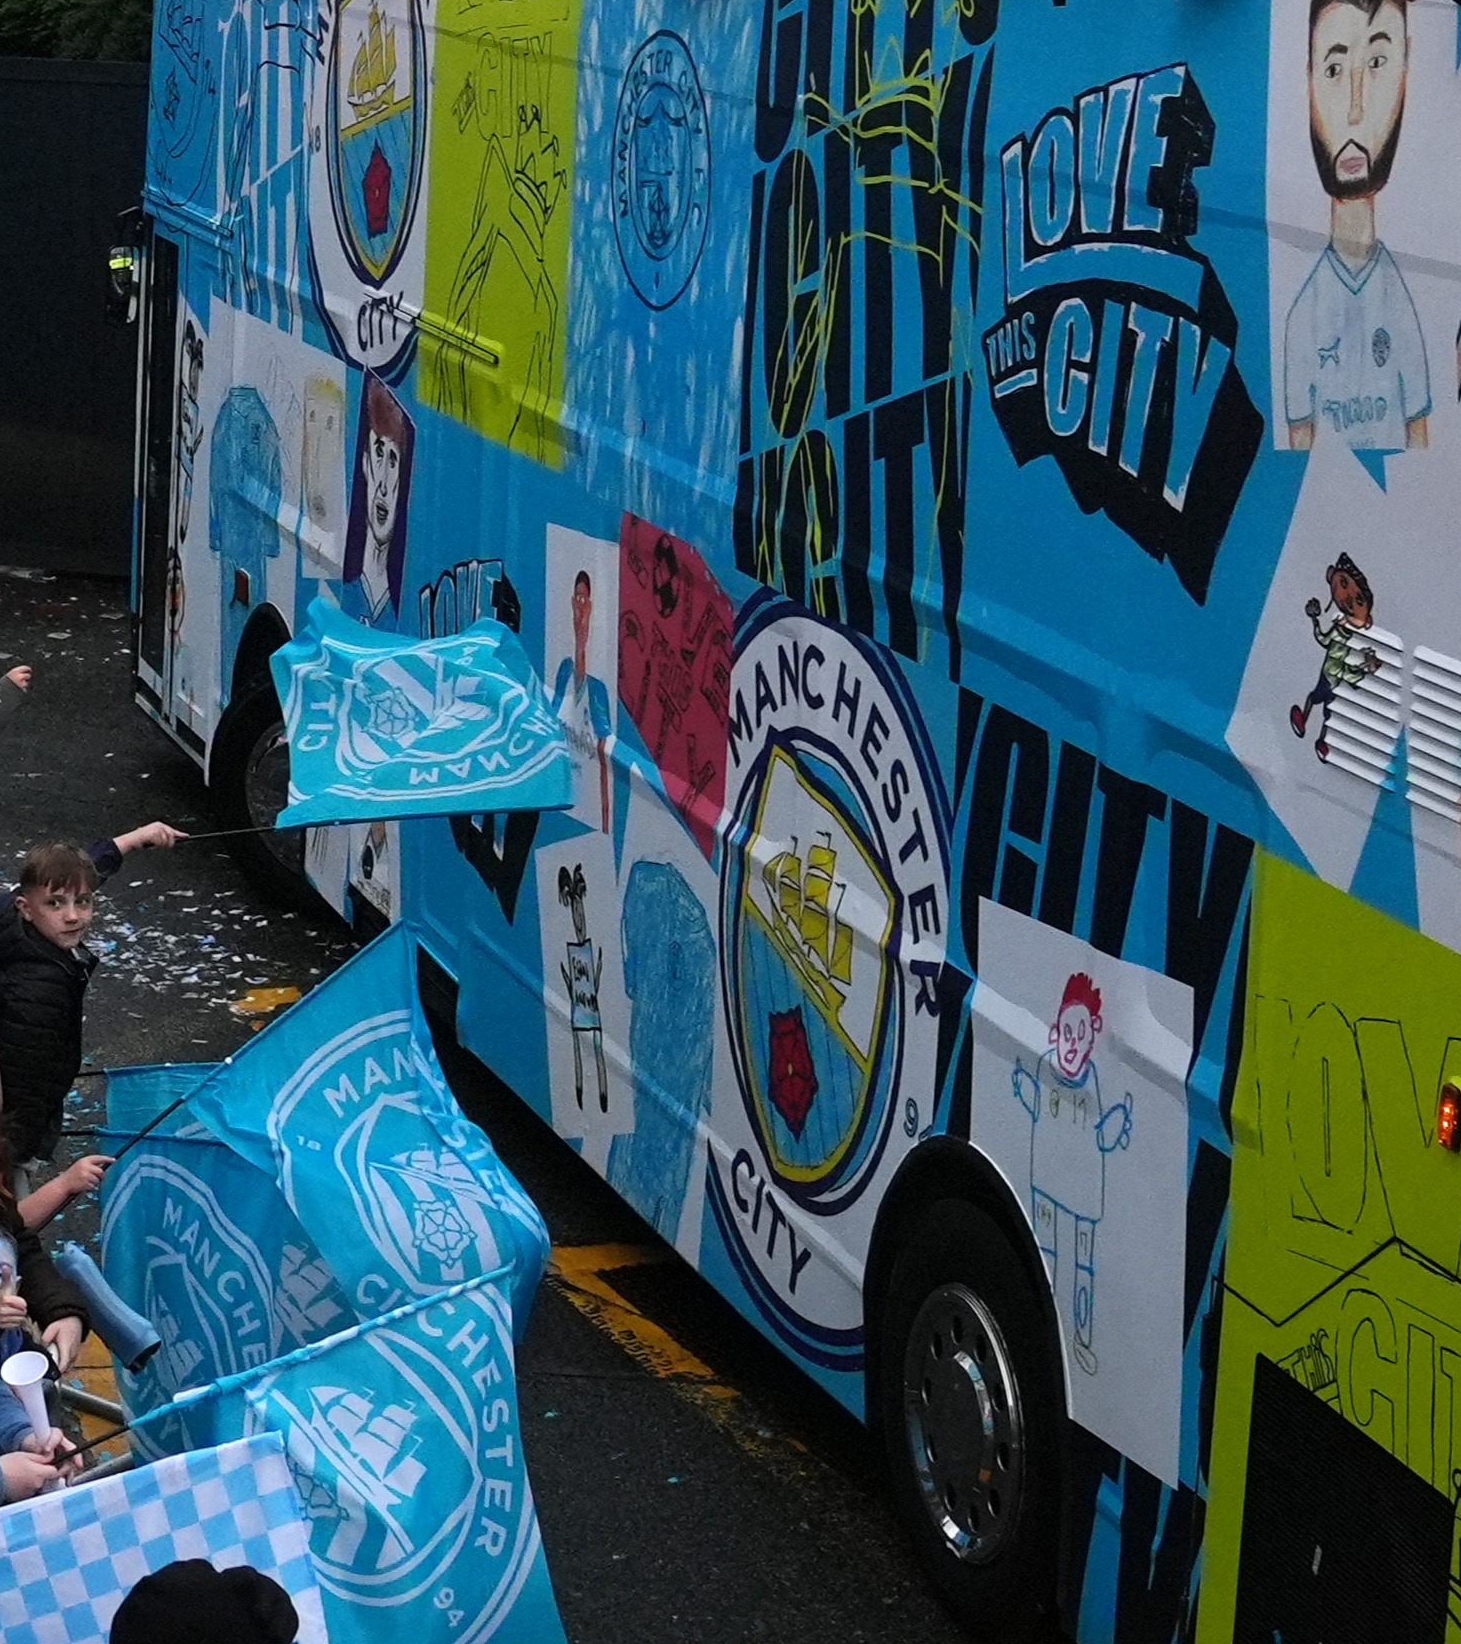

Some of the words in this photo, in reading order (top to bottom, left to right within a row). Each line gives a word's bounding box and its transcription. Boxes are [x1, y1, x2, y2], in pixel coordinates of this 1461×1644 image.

[1002, 63, 1188, 304] LOVE
[356, 290, 404, 352] CITY
[987, 311, 1037, 380] THIS
[1043, 296, 1233, 514] CITY
[728, 643, 941, 1018] MANCHESTER
[163, 1197, 267, 1370] MANCHE
[731, 1147, 811, 1294] CITY
[410, 1301, 512, 1559] CHESTER
[432, 1588, 464, 1629] 94
